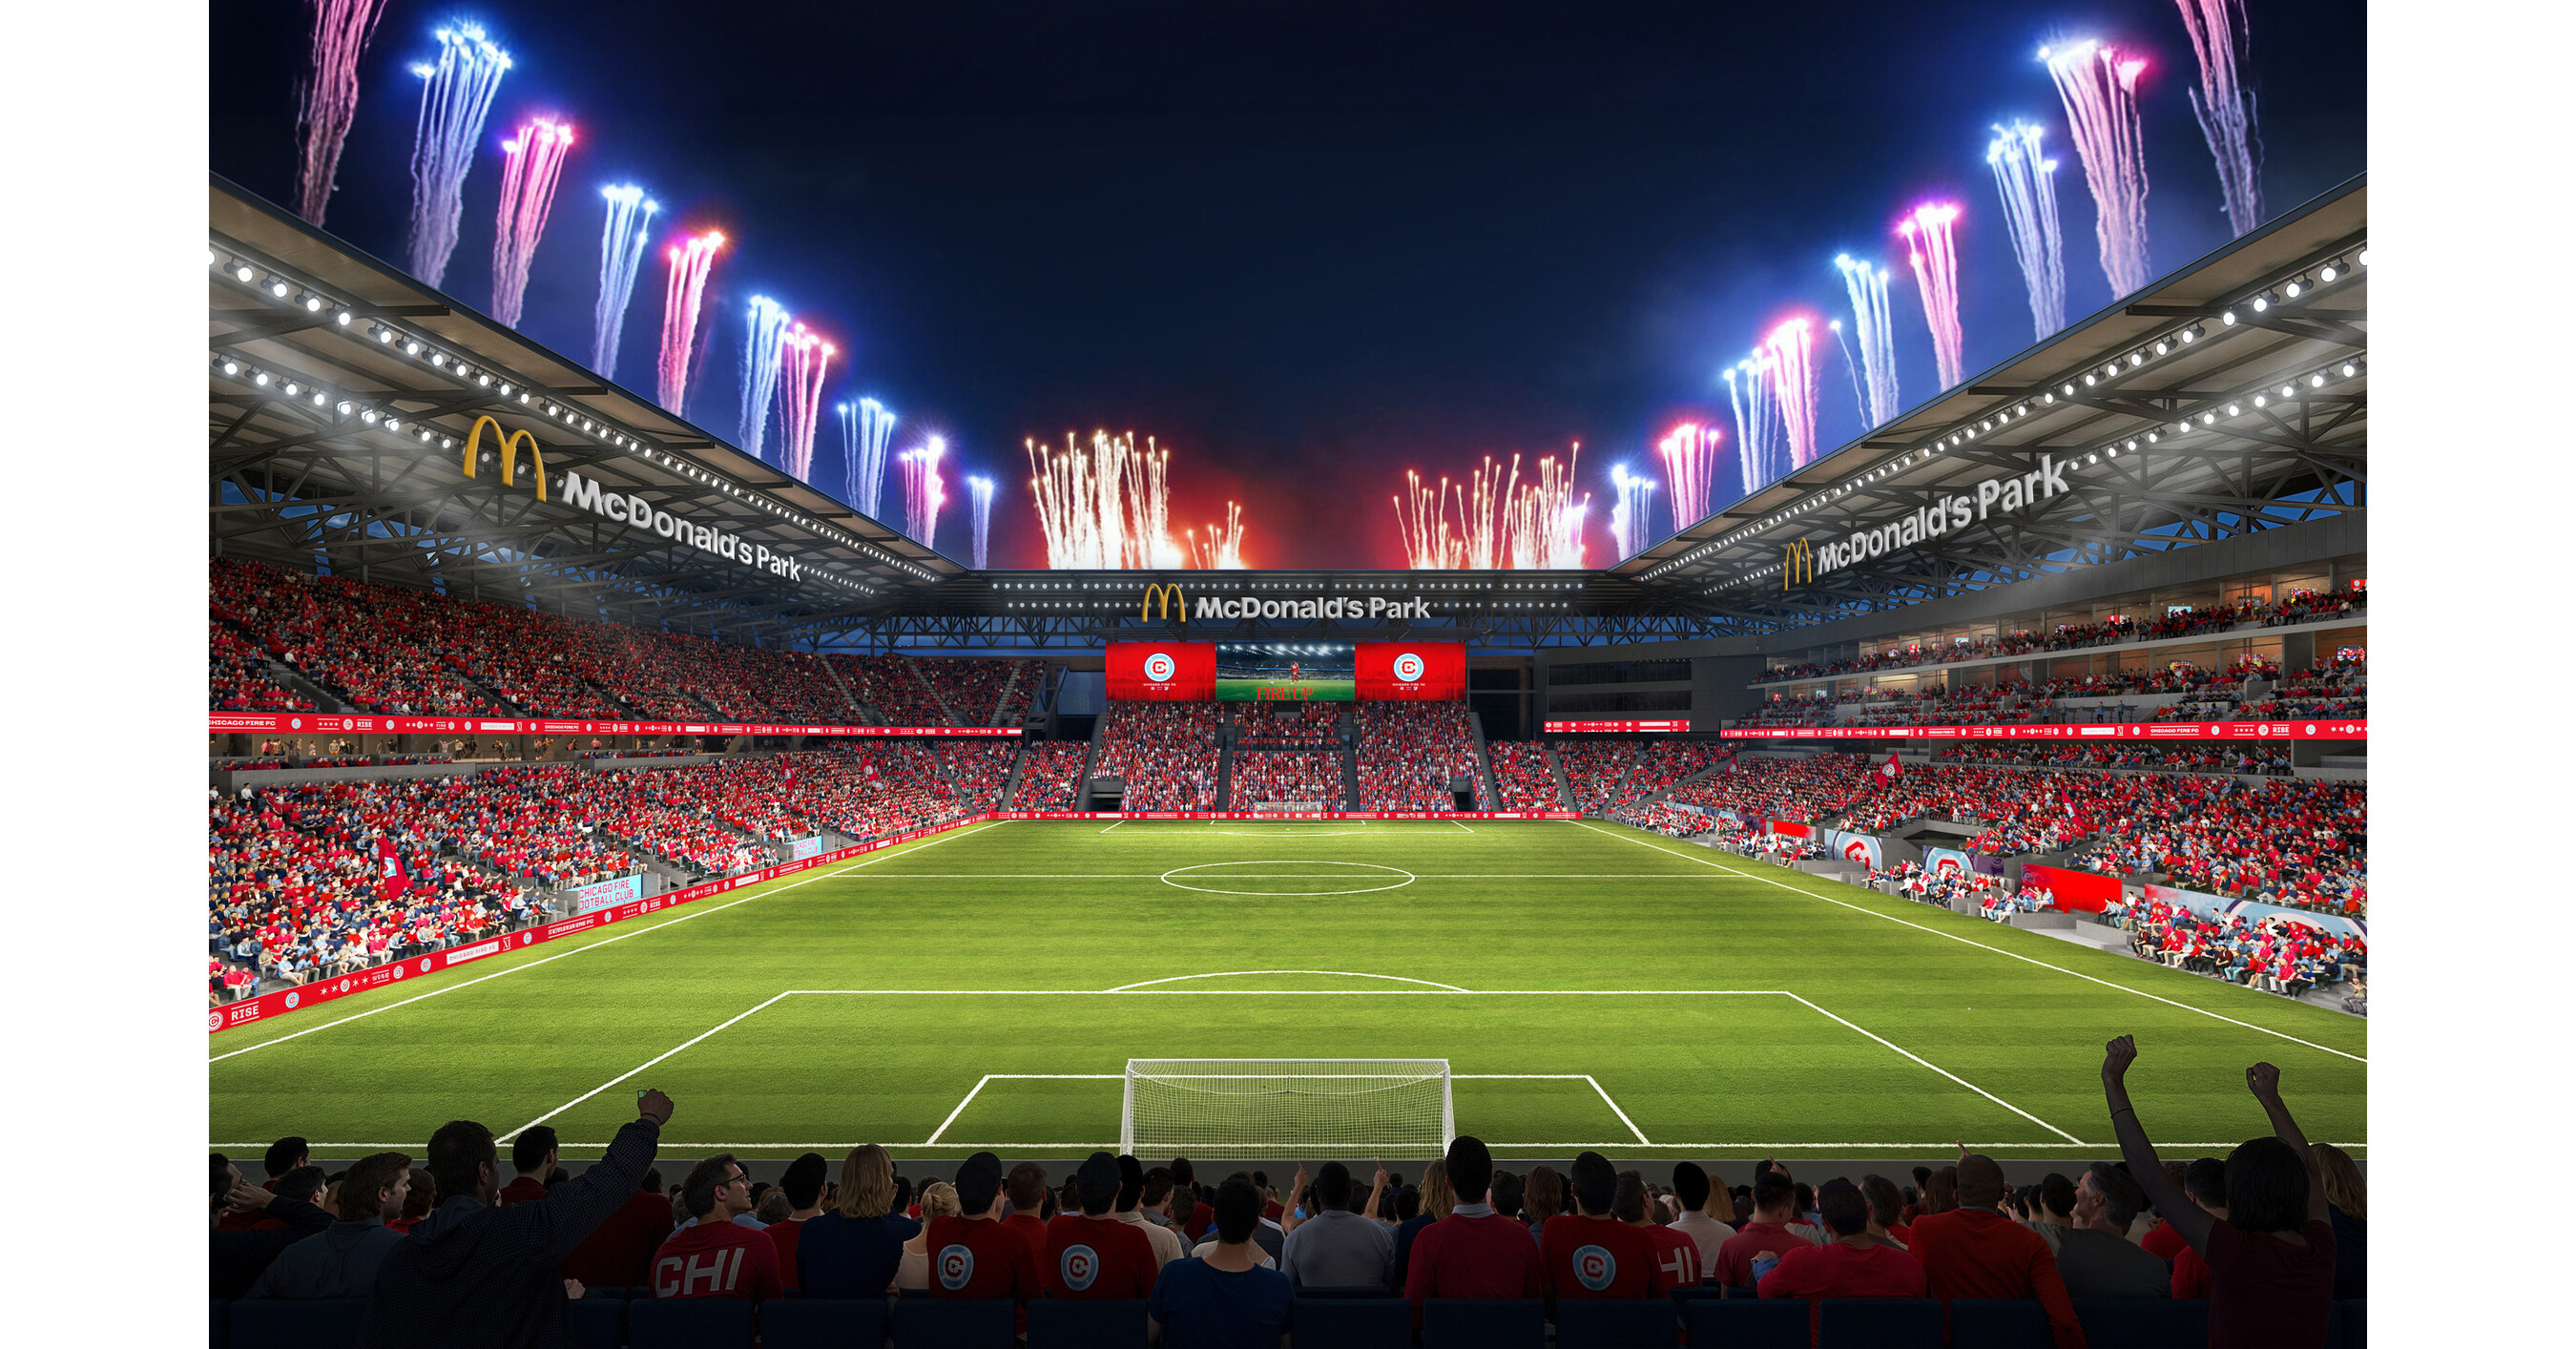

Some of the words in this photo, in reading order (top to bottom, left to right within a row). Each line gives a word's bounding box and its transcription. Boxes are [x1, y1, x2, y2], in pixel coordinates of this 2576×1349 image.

[1818, 494, 1972, 575] McDonald's
[1977, 453, 2070, 521] Park
[562, 470, 753, 566] McDonald's
[757, 544, 800, 582] Park
[1195, 596, 1364, 620] McDonald's
[1369, 596, 1431, 619] Park
[1257, 687, 1291, 700] FIRE
[1293, 687, 1313, 700] UP
[580, 882, 613, 899] CHICAGO
[614, 879, 630, 891] FIRE
[615, 888, 634, 902] CLUB
[231, 1005, 260, 1021] RISE
[655, 1247, 745, 1297] CHI
